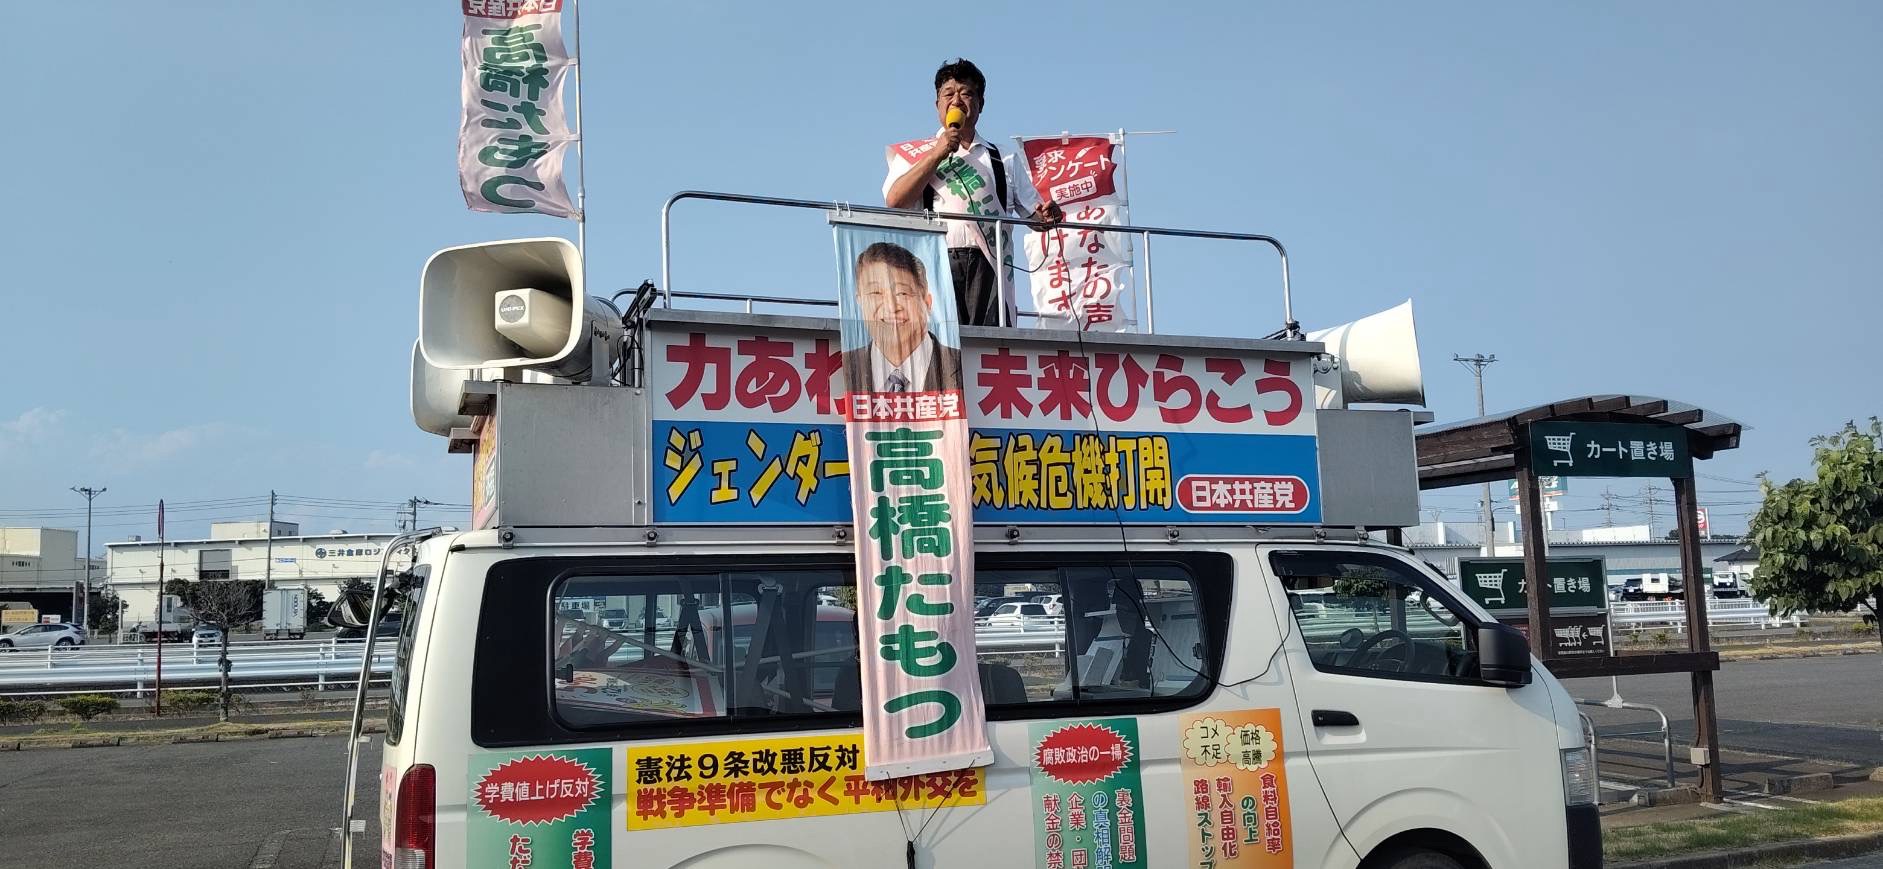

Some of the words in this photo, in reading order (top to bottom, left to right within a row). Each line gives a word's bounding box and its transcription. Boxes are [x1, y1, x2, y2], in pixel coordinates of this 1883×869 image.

[1055, 180, 1094, 200] 実施中
[1041, 211, 1076, 314] けます
[1077, 205, 1114, 331] あなたの声
[977, 348, 1303, 426] 未来ひらこう
[852, 393, 959, 419] 日本共産党
[1586, 440, 1674, 461] カート置き場
[969, 432, 1172, 511] 気候危機打開
[1191, 480, 1295, 509] 日本共産党
[863, 427, 962, 739] 高橋たもつ
[1518, 577, 1591, 594] カ置き場
[1200, 725, 1219, 739] コメ
[1240, 729, 1261, 746] 価格
[635, 744, 859, 785] 憲法9条改悪反対
[1043, 743, 1123, 766] 腐敗政治の一掃
[1200, 744, 1221, 760] 不足
[1241, 749, 1262, 765] 高騰
[484, 777, 589, 803] 学費値上げ反対
[635, 769, 978, 821] 戦争準備でなく平和外交を
[1115, 788, 1136, 863] 裏金問題
[1216, 777, 1237, 859] 輸入自由化
[1241, 796, 1259, 844] の向上
[1260, 773, 1282, 853] 食料自給率
